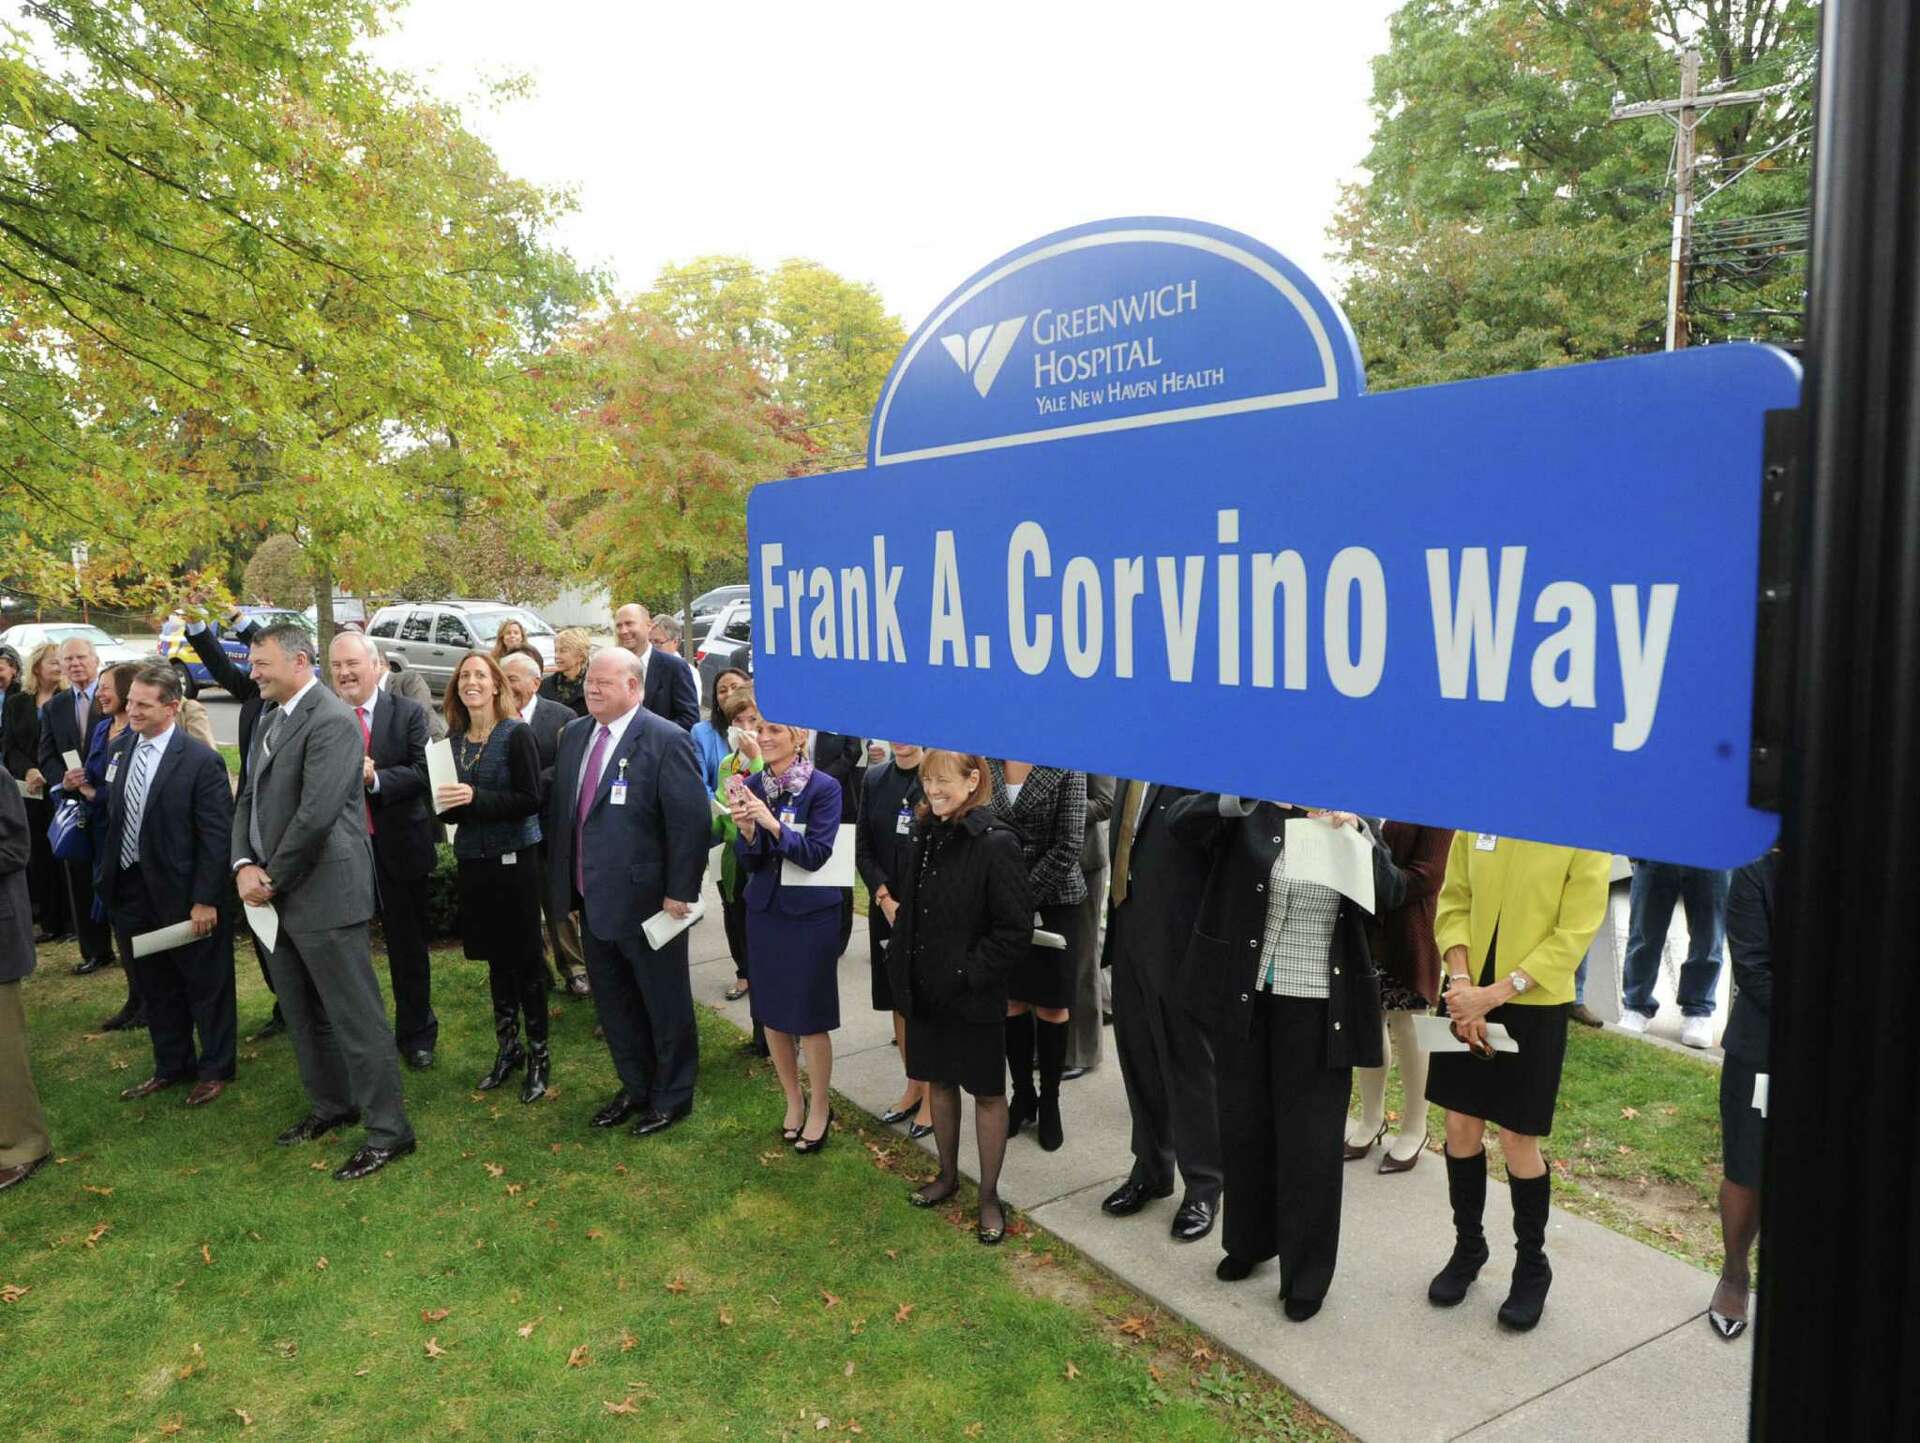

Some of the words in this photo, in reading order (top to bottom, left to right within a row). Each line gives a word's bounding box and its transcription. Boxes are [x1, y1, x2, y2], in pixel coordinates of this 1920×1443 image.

[1032, 279, 1198, 345] GREENWICH
[1034, 337, 1162, 389] HOSPITAL
[1036, 395, 1067, 415] YALE
[1070, 389, 1104, 410] NEW
[1108, 380, 1158, 403] HAVEN
[1162, 368, 1224, 394] HEALTH
[761, 535, 907, 663] Frank
[928, 530, 991, 669] A.
[1007, 509, 1387, 699] Corvino
[1425, 546, 1680, 752] Way
